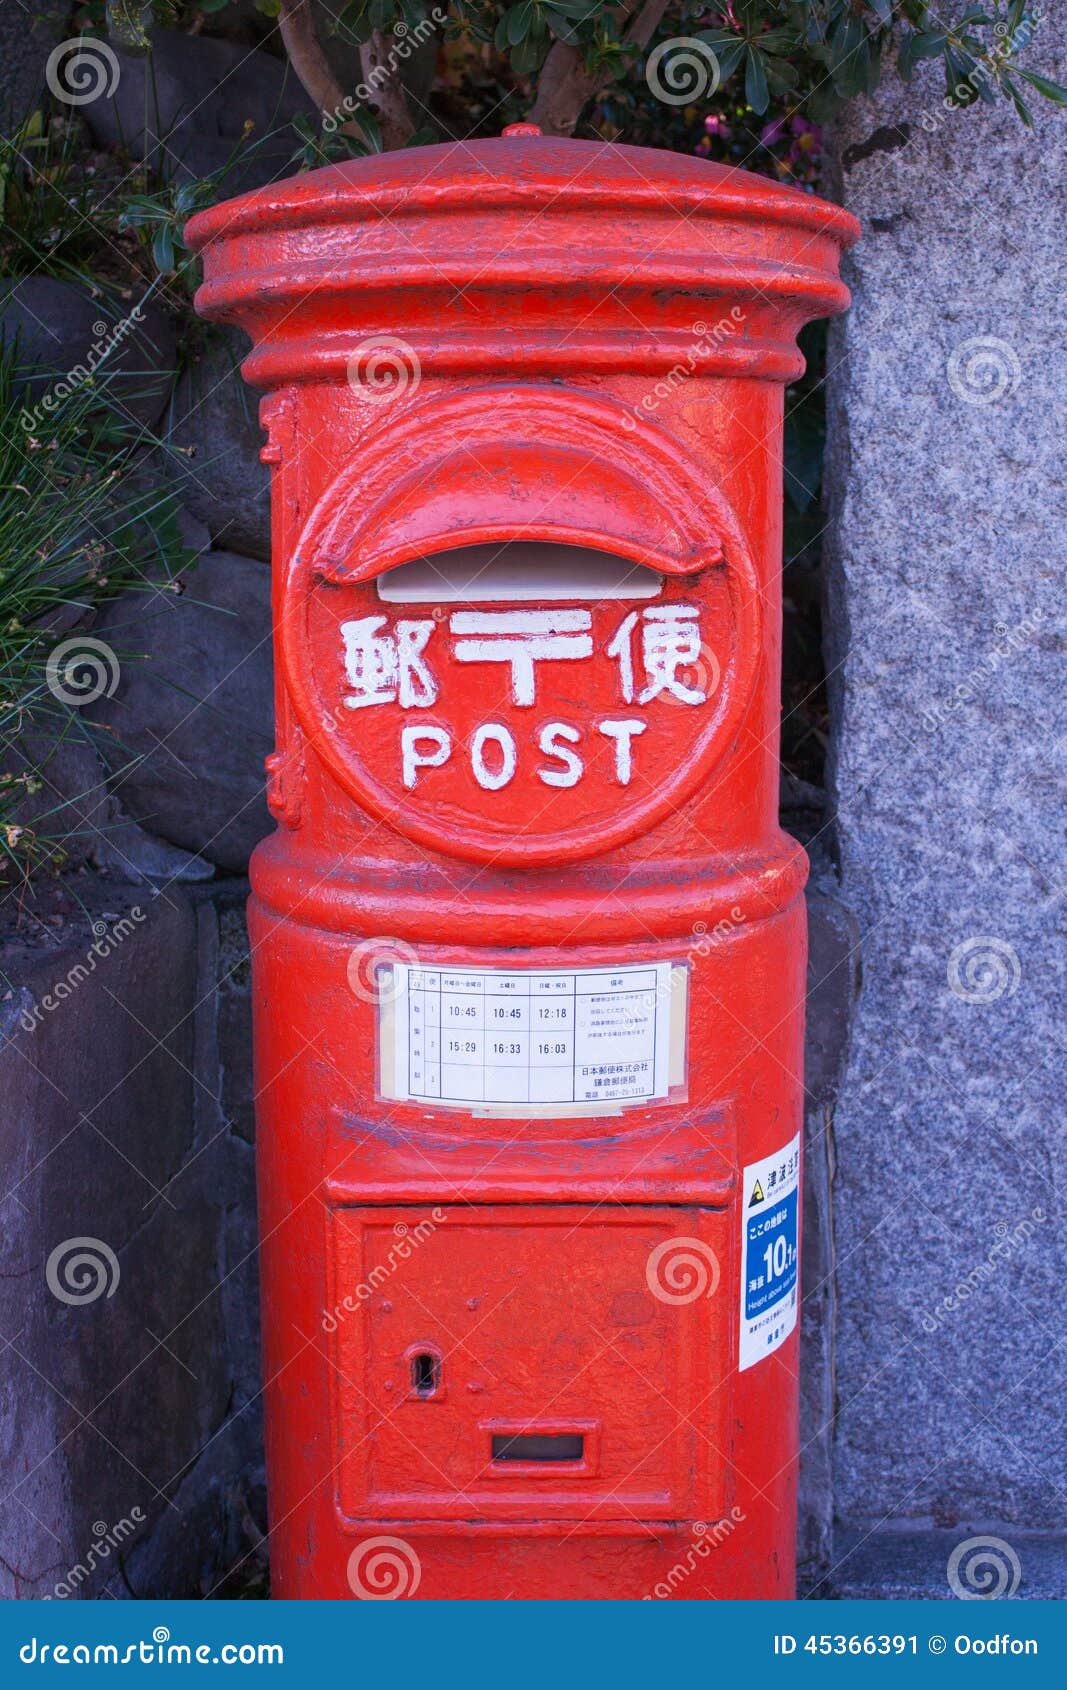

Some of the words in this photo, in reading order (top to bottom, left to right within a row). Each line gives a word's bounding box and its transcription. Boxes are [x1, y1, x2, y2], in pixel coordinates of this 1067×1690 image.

[401, 718, 648, 790] POST
[449, 1006, 476, 1017] 10:45
[493, 1008, 521, 1018] 10:45
[538, 1008, 567, 1018] 12:18
[449, 1041, 476, 1053] 15:29
[493, 1043, 521, 1054] 16:33
[538, 1044, 566, 1054] 16:03
[582, 1062, 649, 1076] 日本郵便株式会社
